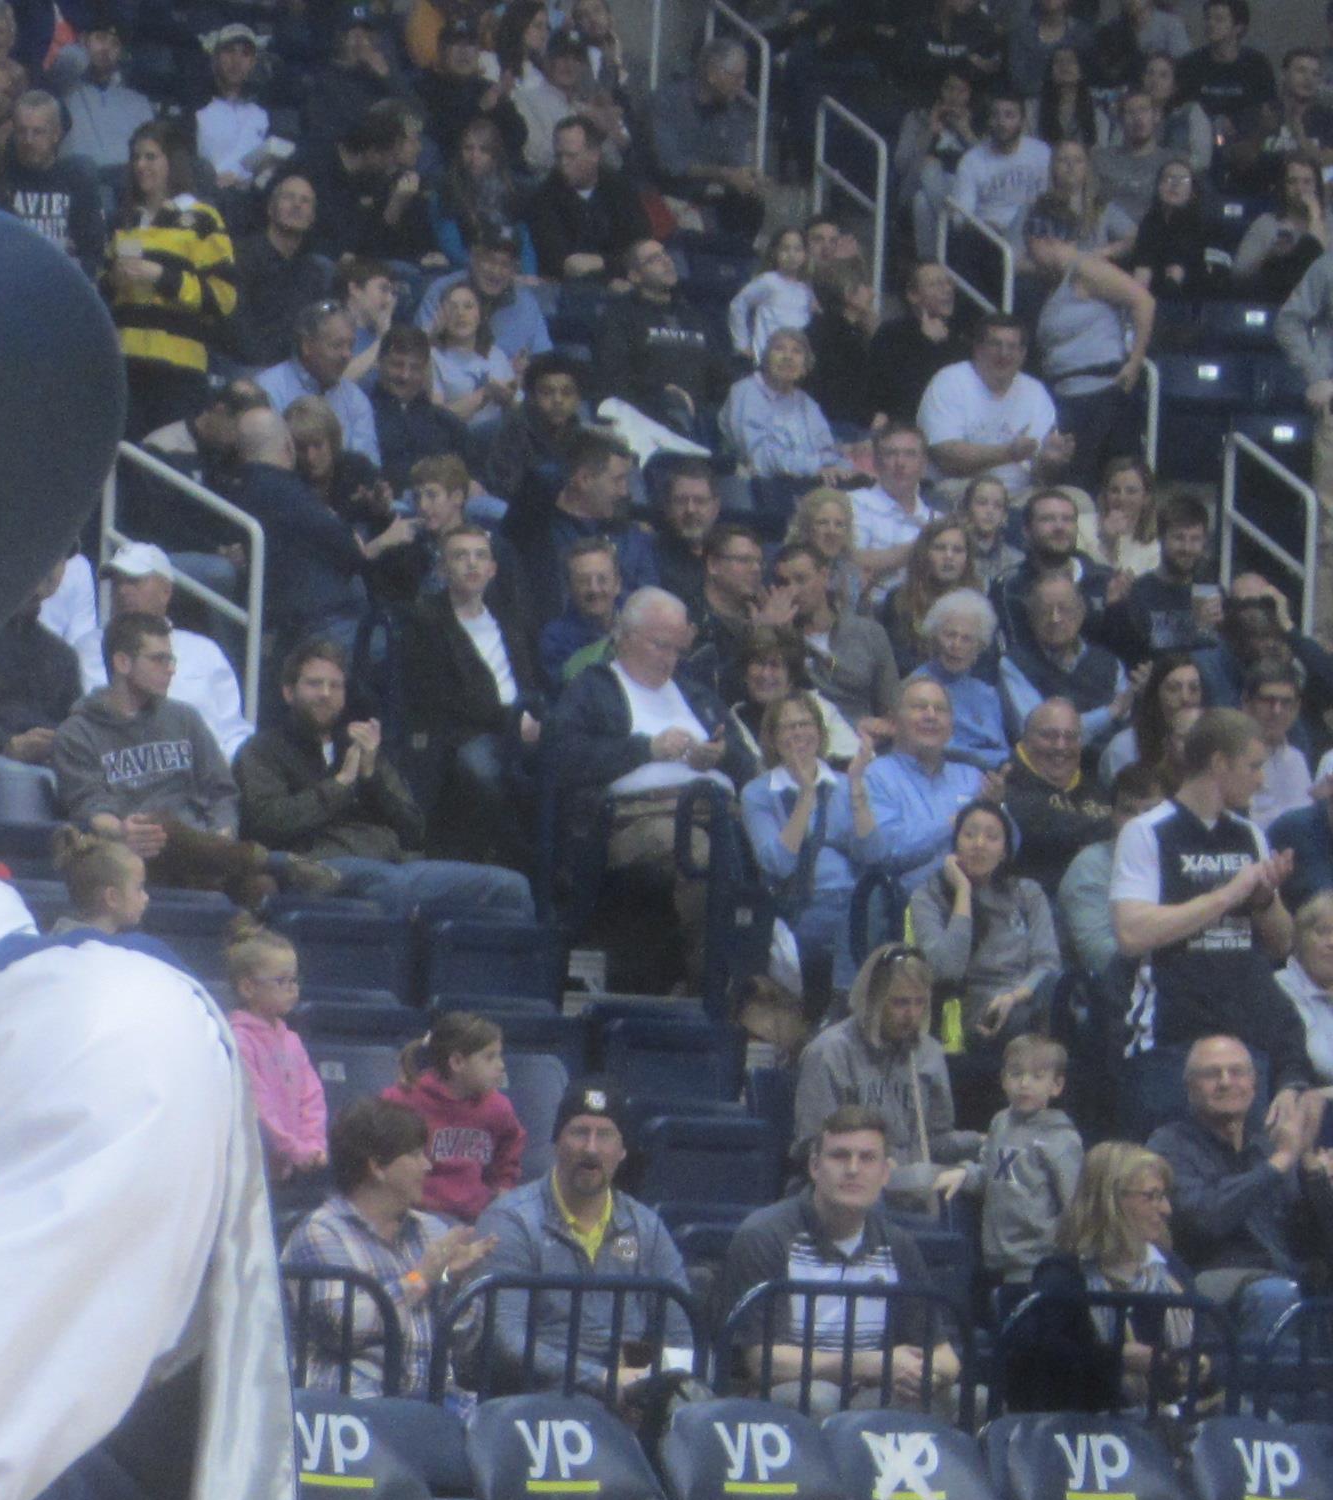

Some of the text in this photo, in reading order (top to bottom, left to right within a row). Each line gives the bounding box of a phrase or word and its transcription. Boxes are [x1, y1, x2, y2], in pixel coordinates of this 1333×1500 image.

[100, 738, 193, 783] XAVIER
[431, 1126, 494, 1166] AVIER
[295, 1411, 371, 1474] yp
[515, 1419, 594, 1479] yp
[713, 1422, 792, 1481] yp
[1054, 1432, 1131, 1490] yp
[1234, 1437, 1301, 1497] yp
